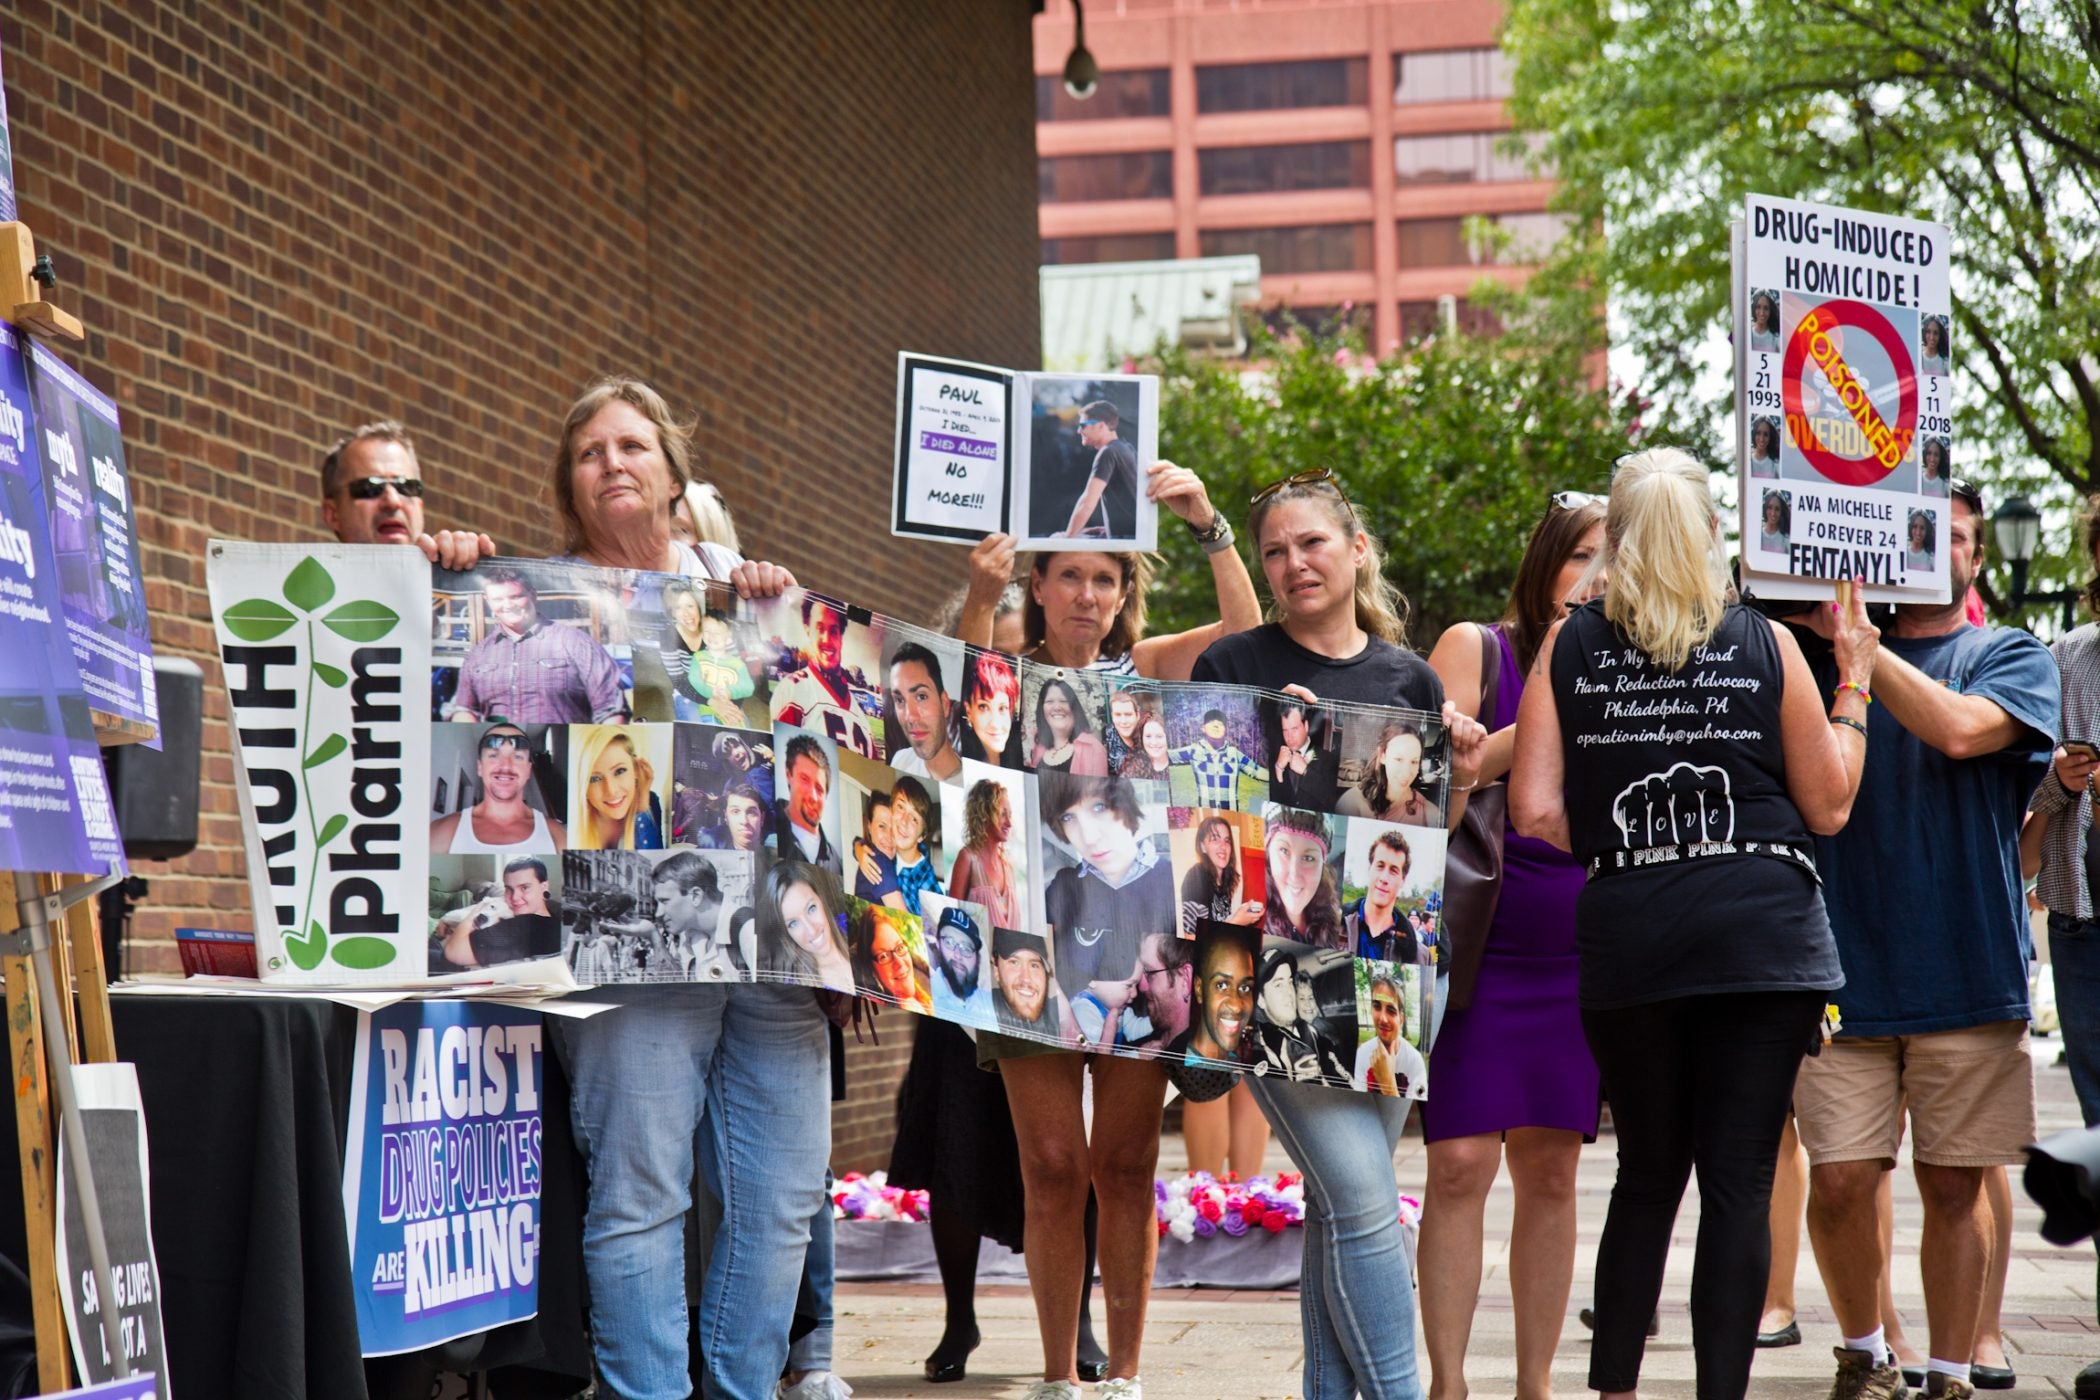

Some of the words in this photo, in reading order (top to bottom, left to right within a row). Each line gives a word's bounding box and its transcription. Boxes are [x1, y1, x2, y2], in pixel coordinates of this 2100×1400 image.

[1755, 205, 1933, 266] DRUG-INDUCED
[1786, 256, 1919, 307] HOMICIDE!
[1760, 353, 1769, 370] 5
[1756, 372, 1771, 388] 21
[1798, 314, 1901, 469] POISONED
[1930, 376, 1938, 392] 5
[939, 384, 983, 405] PAUL
[1748, 390, 1782, 408] 1993
[1926, 396, 1940, 413] 11
[941, 419, 949, 429] I
[1919, 415, 1951, 433] 2018
[921, 433, 928, 446] I
[931, 437, 955, 451] DIED
[958, 440, 997, 458] ALONE
[1784, 414, 1916, 463] OVERDOES
[945, 462, 967, 478] NO
[928, 489, 984, 509] MORE!!!
[1798, 495, 1821, 513] AVA
[1828, 497, 1892, 520] MICHELLE
[1808, 522, 1872, 546] FOREVER
[1879, 531, 1897, 549] 24
[1790, 543, 1906, 585] FENTANYL!
[1622, 649, 1644, 669] My
[1615, 673, 1687, 693] Reduction
[1692, 670, 1761, 693] Advocacy
[1705, 696, 1729, 714] PA
[1576, 722, 1763, 748] operationimby@yahoo.com
[328, 647, 401, 934] Pharm
[1633, 845, 1679, 866] PINK
[1688, 841, 1737, 857] PINK
[381, 1025, 542, 1125] RACIST
[379, 1127, 443, 1224] DRUG
[445, 1117, 541, 1211] POLICIES
[372, 1251, 404, 1283] ARE
[404, 1203, 534, 1314] KILLING
[82, 1264, 125, 1315] SANG
[126, 1261, 152, 1306] LIVES
[120, 1316, 134, 1361] OT
[137, 1315, 147, 1357] A
